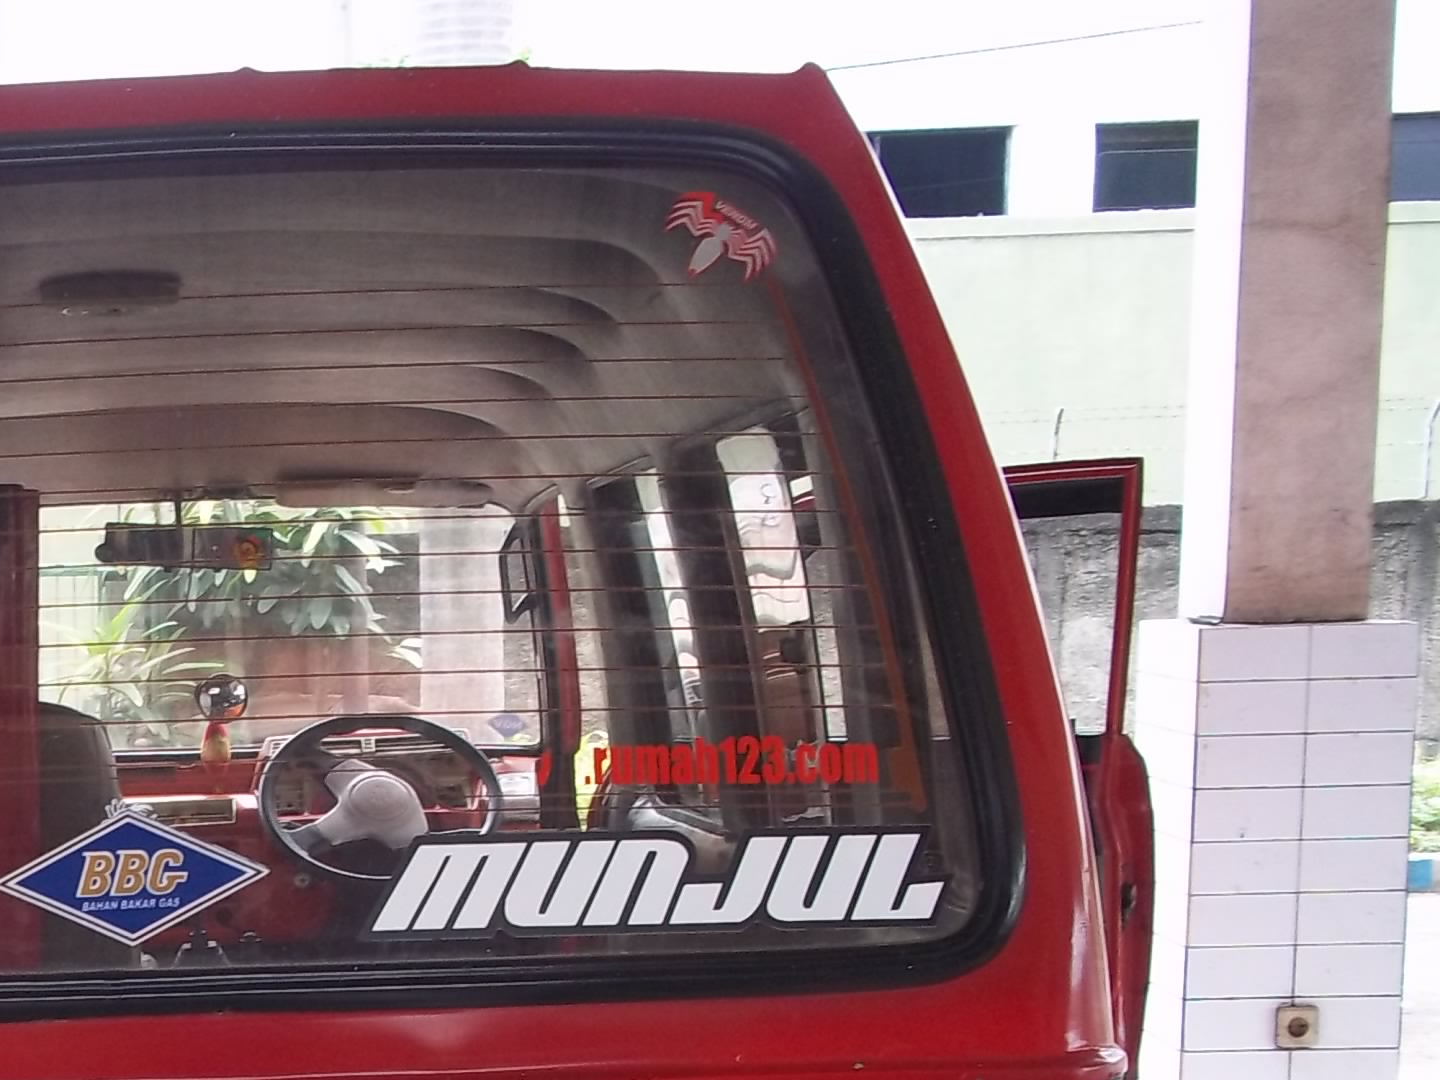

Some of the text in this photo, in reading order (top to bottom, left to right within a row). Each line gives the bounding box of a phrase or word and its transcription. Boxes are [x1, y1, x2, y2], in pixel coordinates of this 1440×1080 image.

[714, 199, 760, 231] VENOM
[75, 848, 189, 898] BBG
[371, 833, 945, 932] MUNJUL
[82, 897, 181, 912] BAHAN BAKAR GAS
